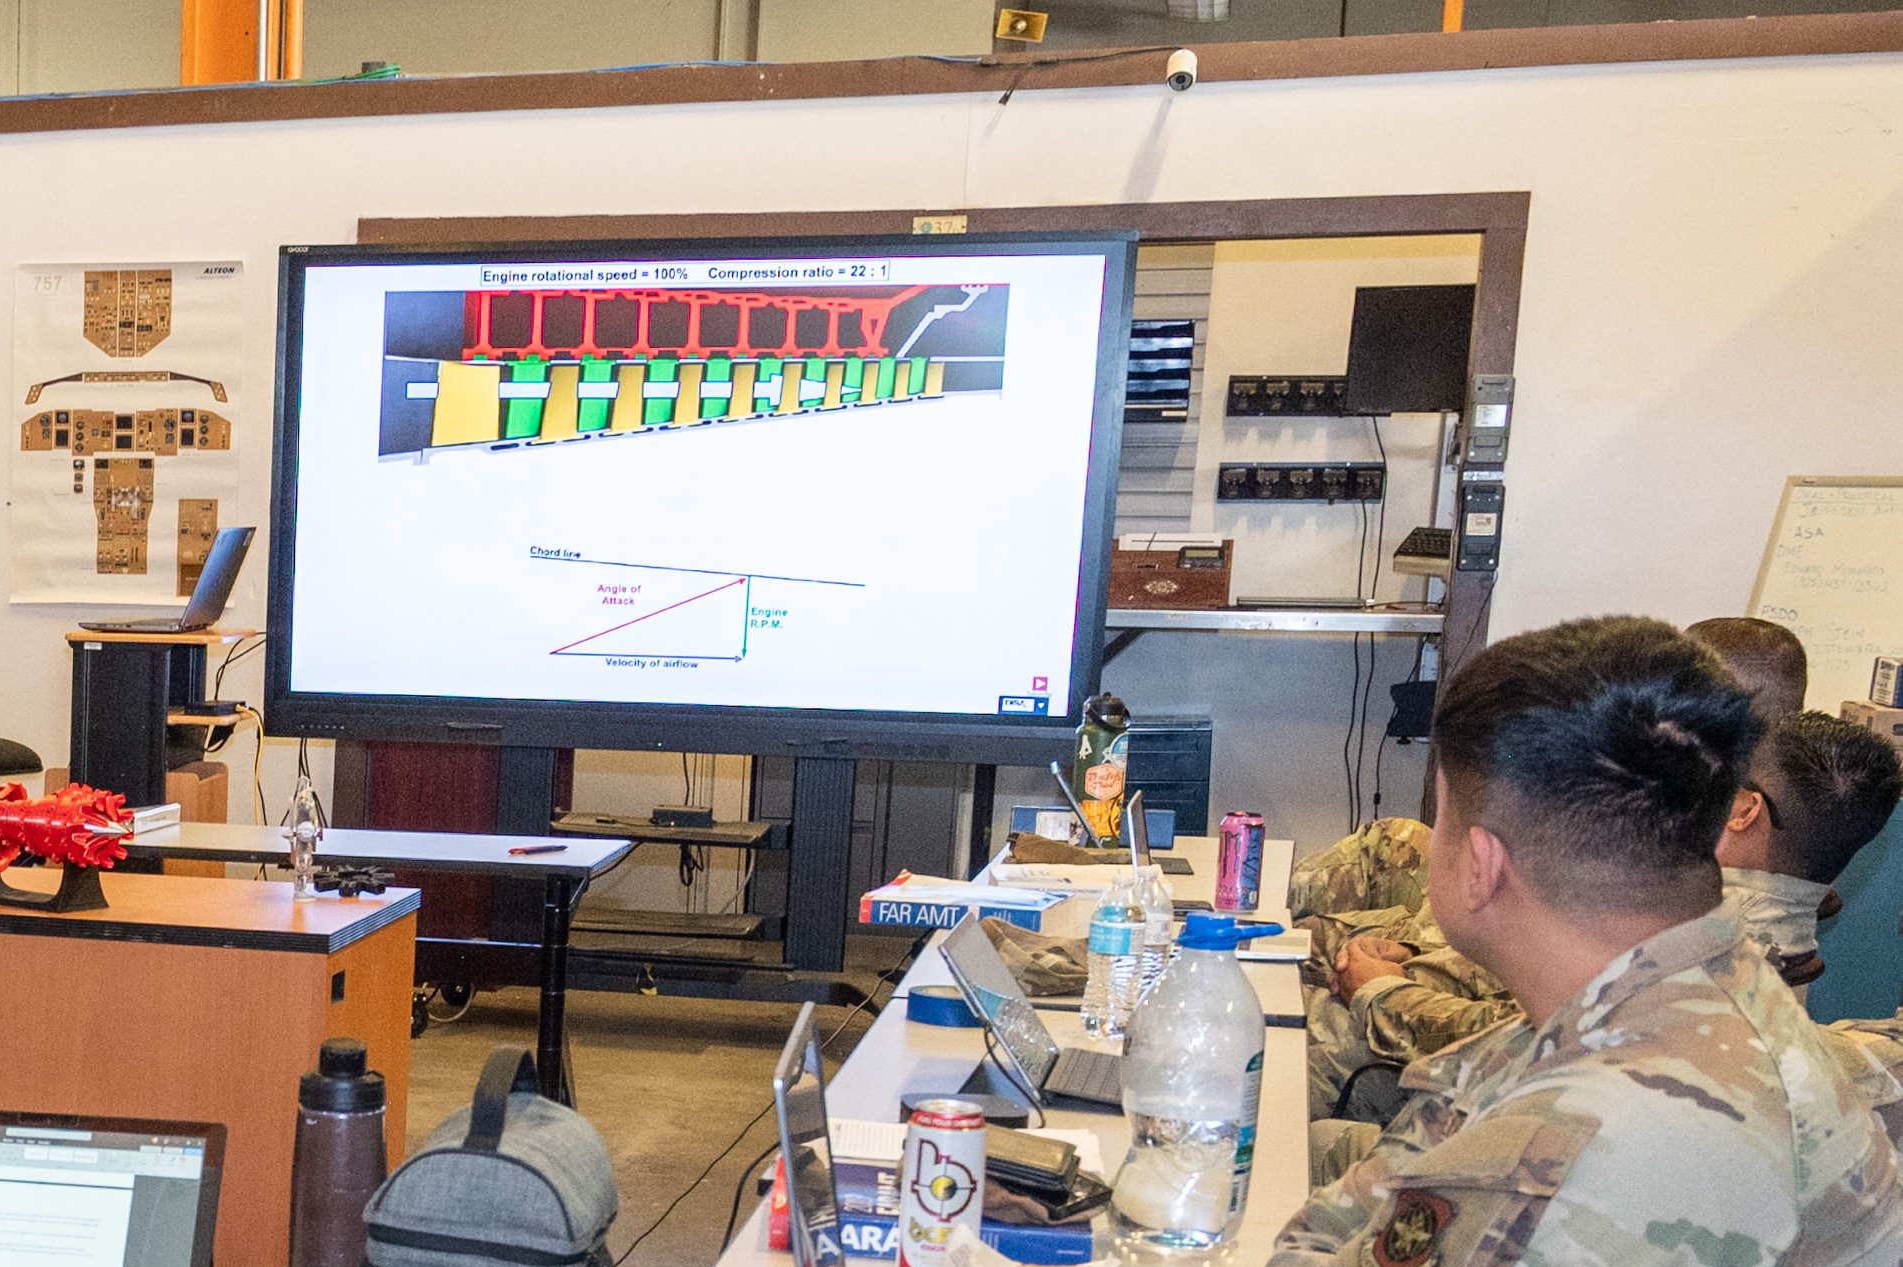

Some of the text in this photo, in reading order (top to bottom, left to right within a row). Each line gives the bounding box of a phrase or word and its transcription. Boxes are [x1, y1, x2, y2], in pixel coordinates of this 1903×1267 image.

[483, 270, 527, 284] Engine
[532, 269, 593, 281] rotational
[597, 269, 637, 283] speed
[654, 268, 688, 280] 100%
[708, 266, 798, 280] Compression
[803, 266, 833, 278] ratio
[851, 265, 866, 277] 22
[33, 276, 62, 290] 757
[1794, 526, 1825, 539] ASA
[530, 546, 581, 559] Chord line
[598, 584, 642, 594] Angle of
[602, 597, 635, 605] Attack
[751, 607, 788, 618] Engine
[750, 619, 783, 629] R.P.M.
[605, 658, 698, 669] Velocity of airflow
[879, 902, 960, 927] FAR AMT
